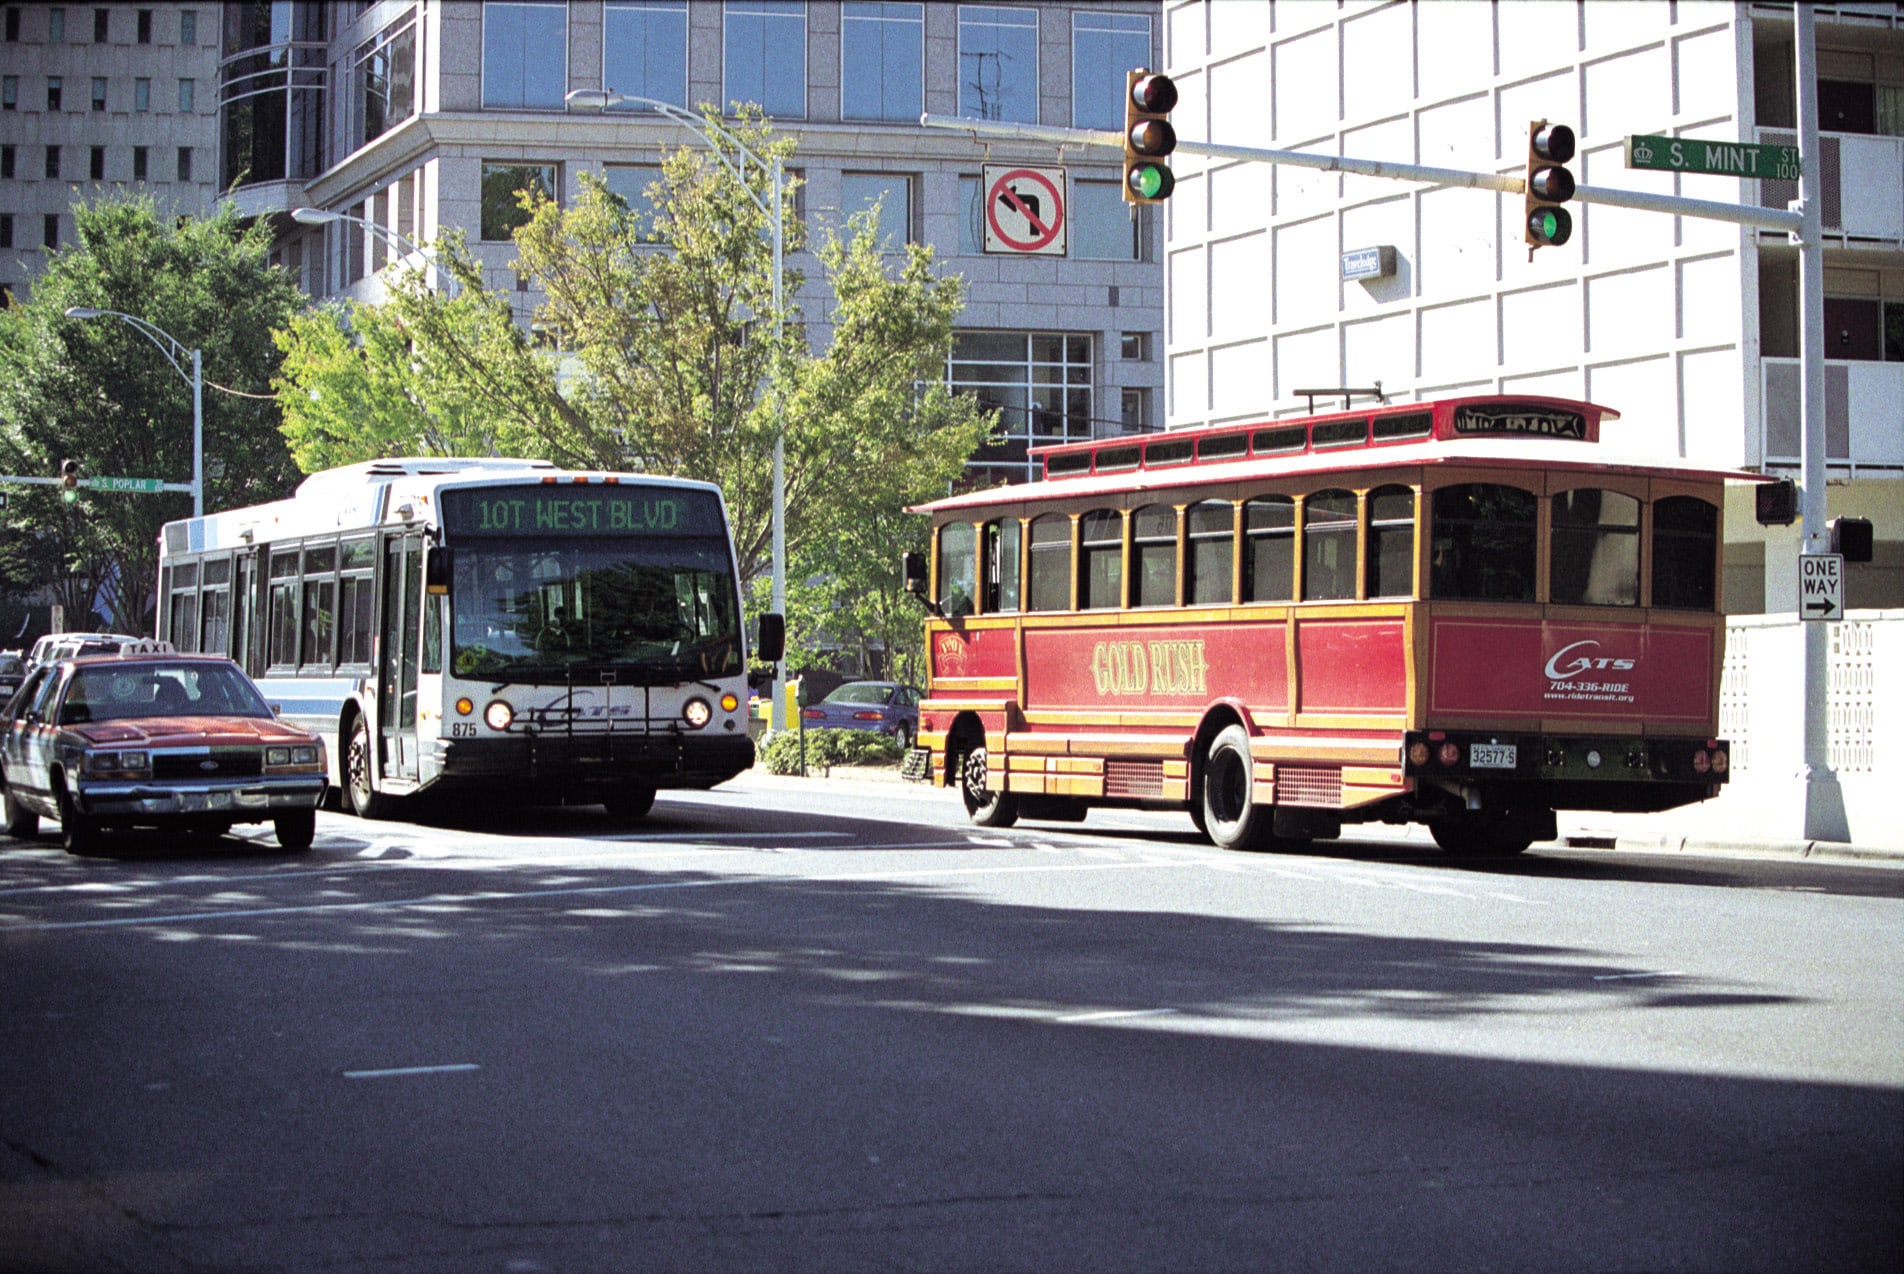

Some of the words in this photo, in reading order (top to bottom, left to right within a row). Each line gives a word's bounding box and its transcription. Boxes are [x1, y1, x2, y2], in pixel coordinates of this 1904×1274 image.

[1669, 142, 1690, 168] S.
[1705, 145, 1760, 173] MINT
[1781, 148, 1797, 164] ST
[1776, 164, 1799, 180] 100
[113, 479, 146, 490] POPLAR
[480, 500, 525, 530] 10T
[536, 500, 601, 530] WEST
[610, 500, 679, 531] BLVD
[1804, 560, 1837, 576] ONE
[1803, 579, 1839, 595] WAY
[130, 643, 167, 654] TAXI
[1091, 641, 1148, 696] GOLD
[1148, 640, 1207, 696] RUSH
[1544, 640, 1636, 680] CATS
[1549, 681, 1630, 693] 704-336-RIDE
[1543, 693, 1635, 703] www.ridetransit.org
[452, 722, 477, 738] 875
